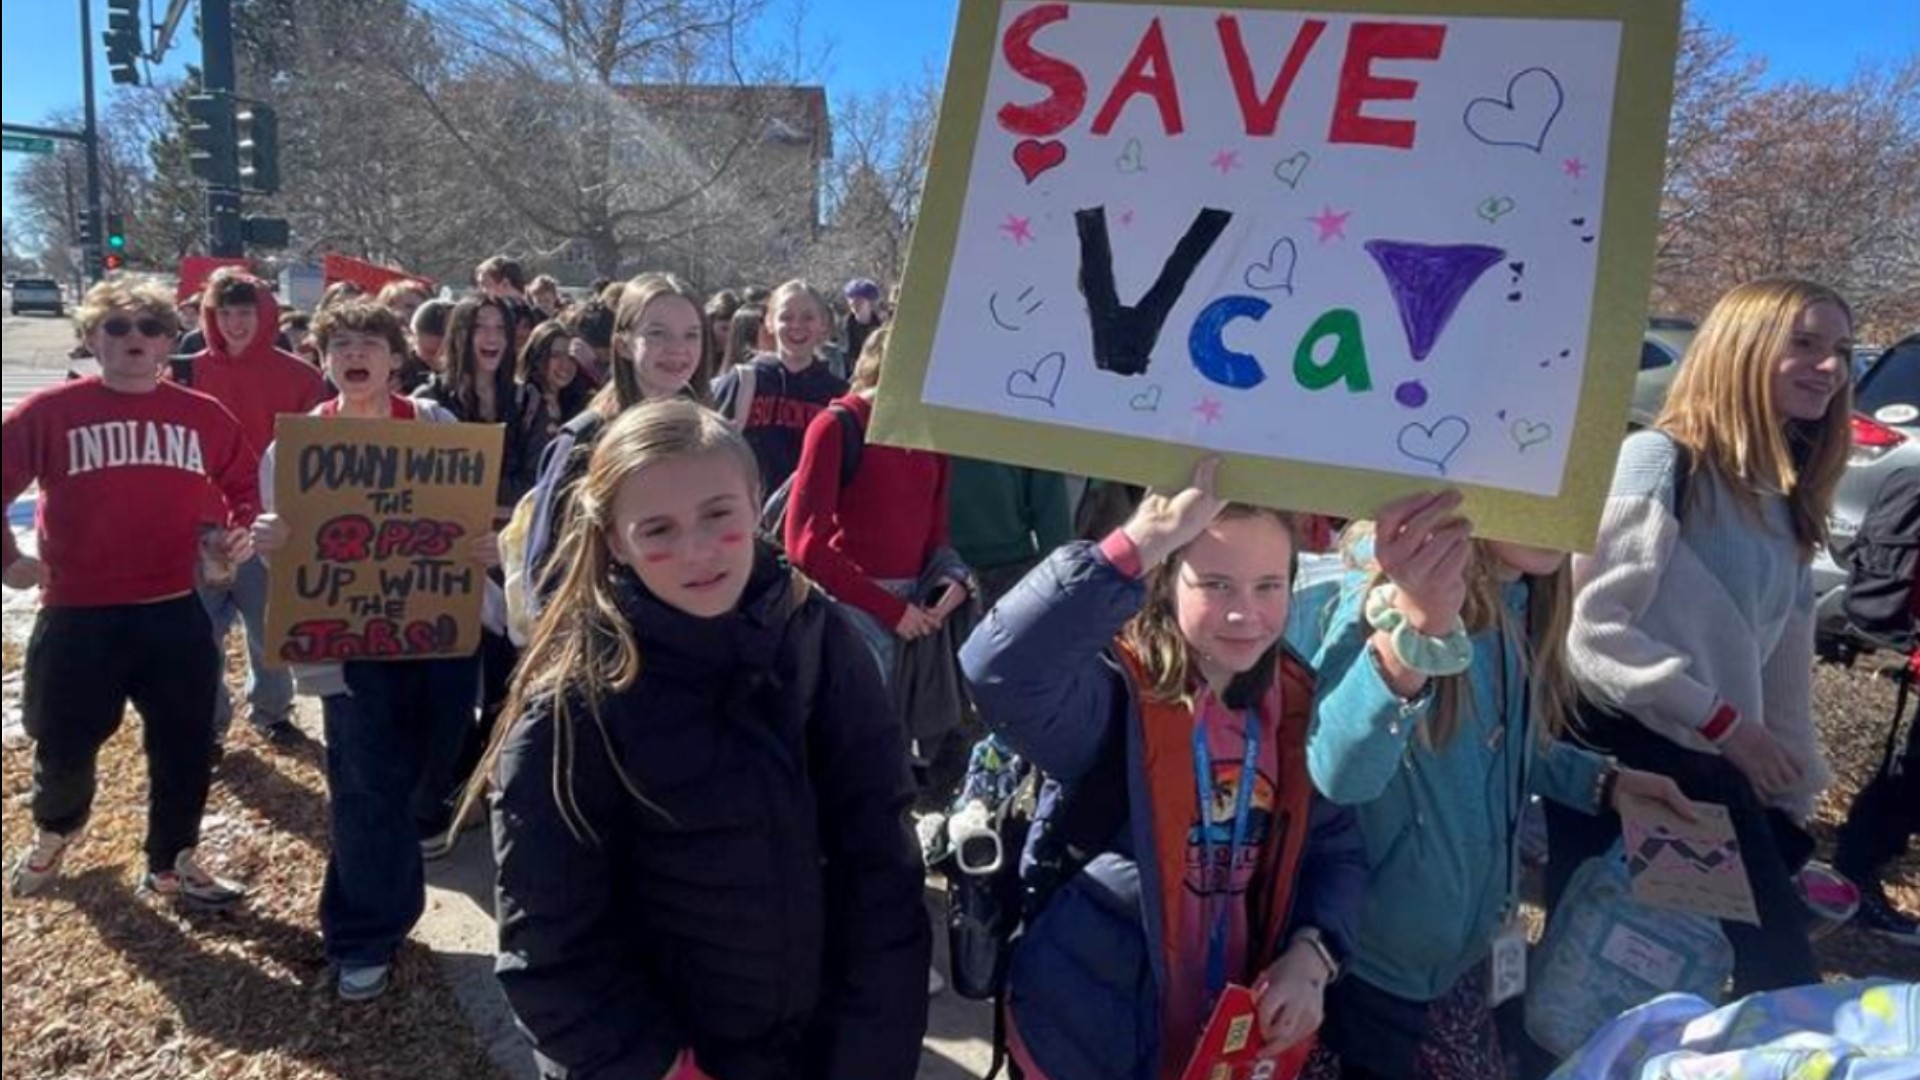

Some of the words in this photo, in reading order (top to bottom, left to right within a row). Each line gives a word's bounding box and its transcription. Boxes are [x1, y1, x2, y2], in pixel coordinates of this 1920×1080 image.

[997, 3, 1447, 149] SAVE
[67, 420, 206, 476] INDIANA
[300, 442, 398, 493] DOWN
[367, 489, 413, 514] THE
[297, 564, 356, 606] UP
[379, 559, 471, 595] WITH
[348, 595, 406, 619] THE
